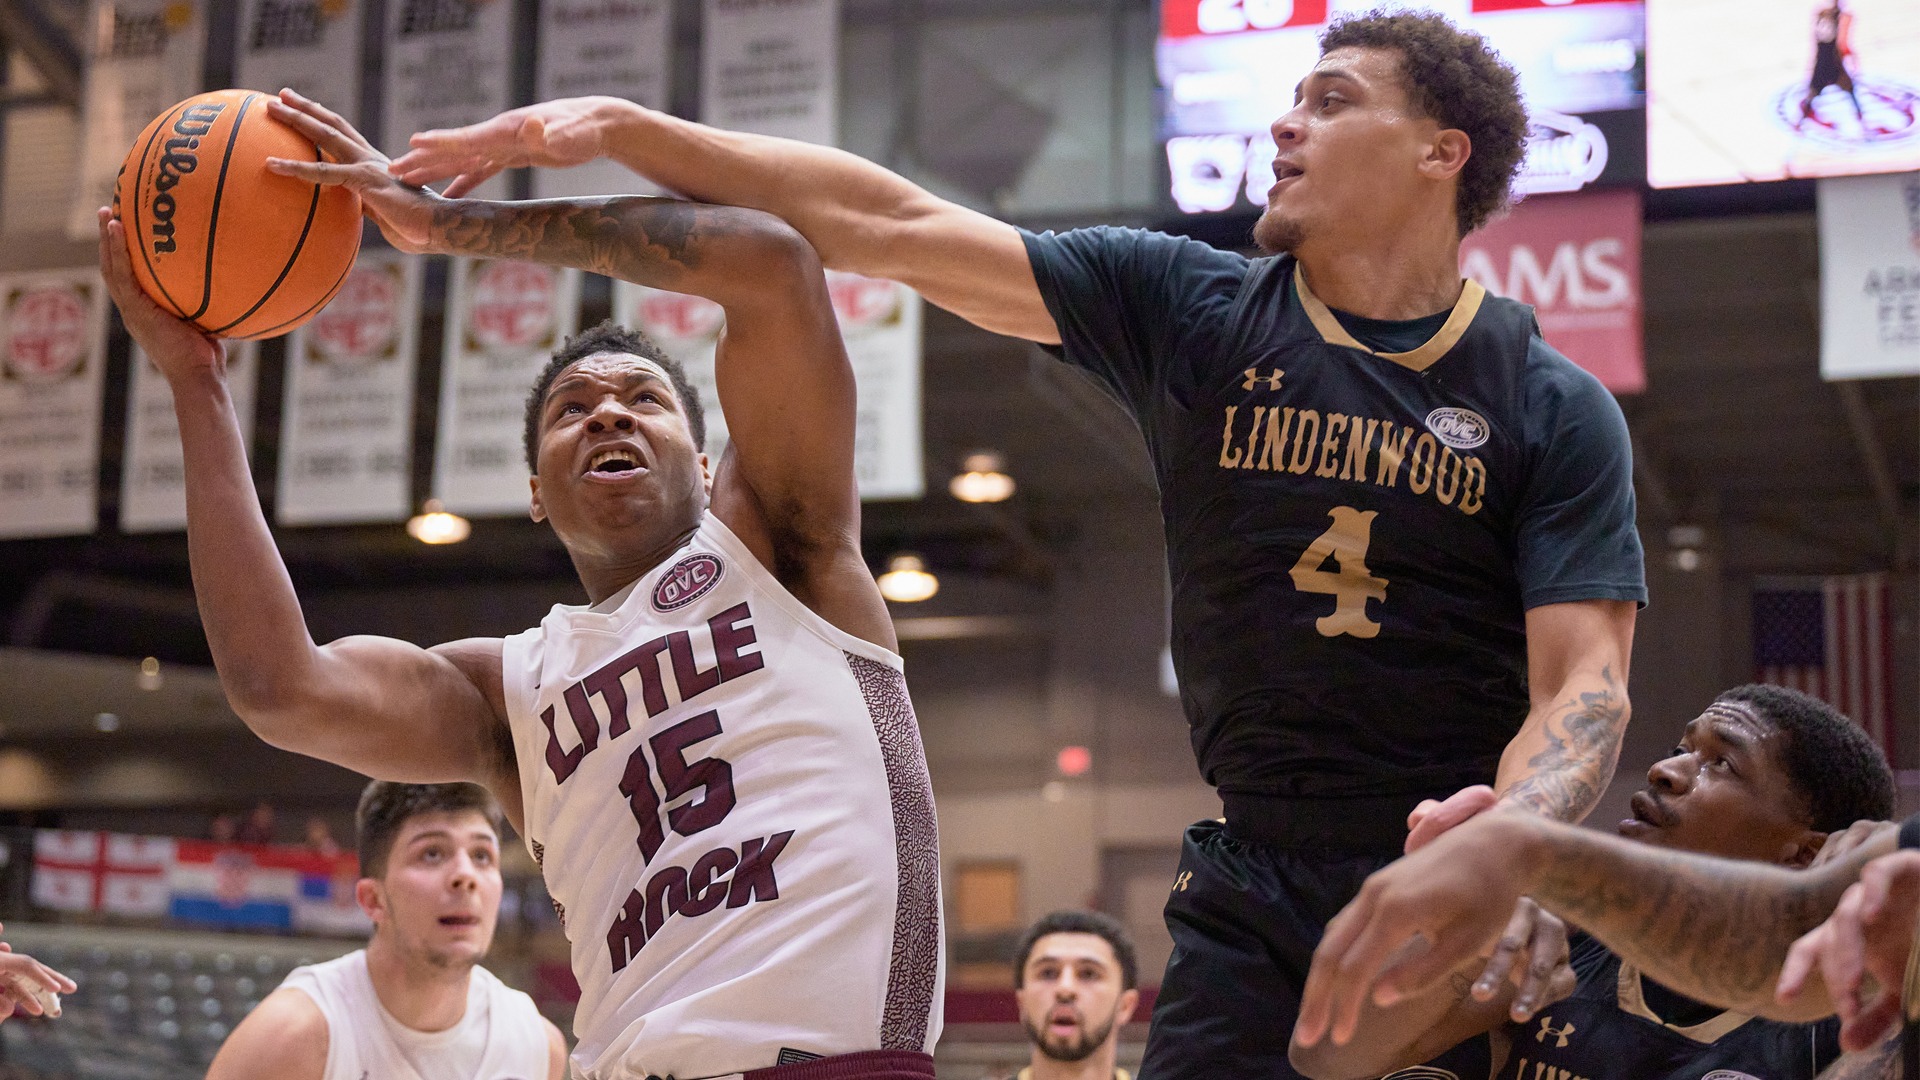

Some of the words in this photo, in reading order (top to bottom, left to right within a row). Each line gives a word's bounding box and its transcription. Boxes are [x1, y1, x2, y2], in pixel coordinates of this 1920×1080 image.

[153, 103, 228, 255] Wilson
[1218, 405, 1488, 515] LINDENWOOD
[1436, 416, 1479, 440] OVC
[664, 562, 708, 602] OVC
[1288, 505, 1390, 639] 4
[540, 600, 765, 786] LITTLE
[617, 708, 737, 869] 15
[605, 829, 796, 975] ROCK
